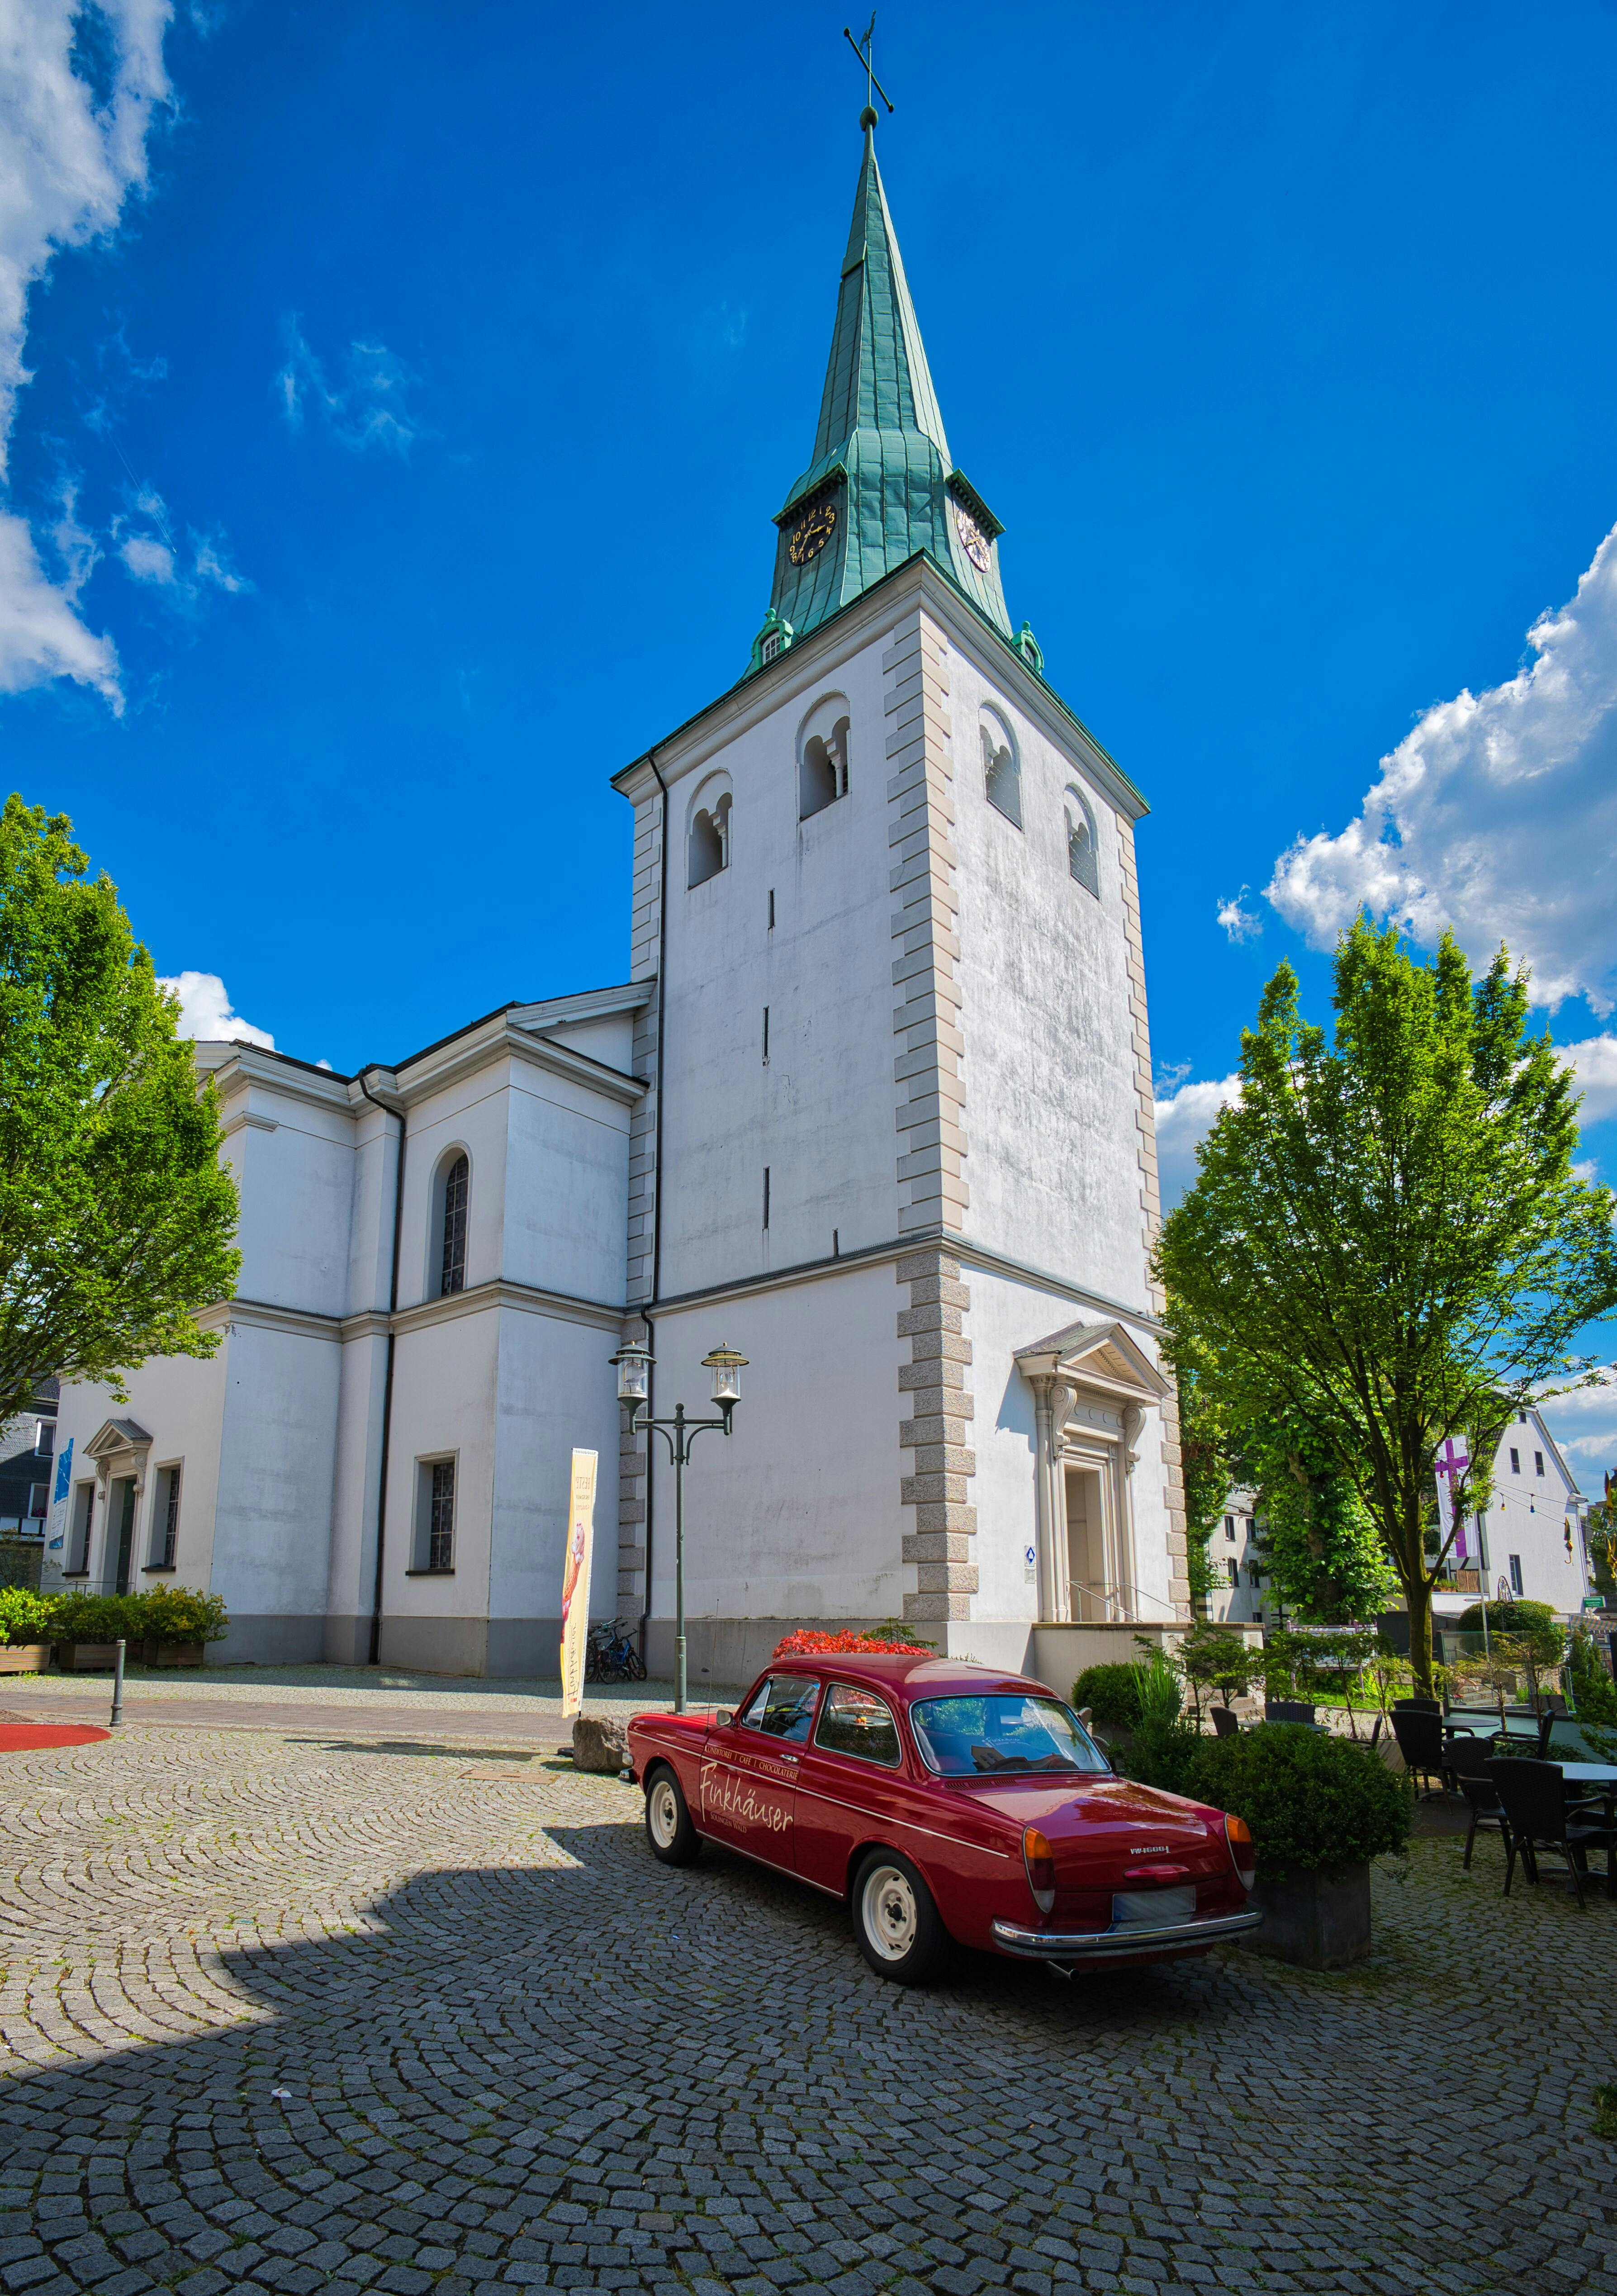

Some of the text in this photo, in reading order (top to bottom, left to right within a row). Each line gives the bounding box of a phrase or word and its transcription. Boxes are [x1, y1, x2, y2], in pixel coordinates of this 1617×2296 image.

[808, 509, 816, 522] 12
[825, 506, 831, 517] 2
[829, 512, 835, 523] 3
[801, 519, 806, 530] 11
[826, 526, 832, 535] 4
[793, 531, 801, 544] 10
[818, 537, 824, 547] 5
[789, 546, 795, 555] 9
[808, 548, 814, 557] 6
[705, 1745, 799, 1780] CONDITOREI CAFÉ CHOCOLATERIE
[700, 1762, 794, 1832] Finkhäuser
